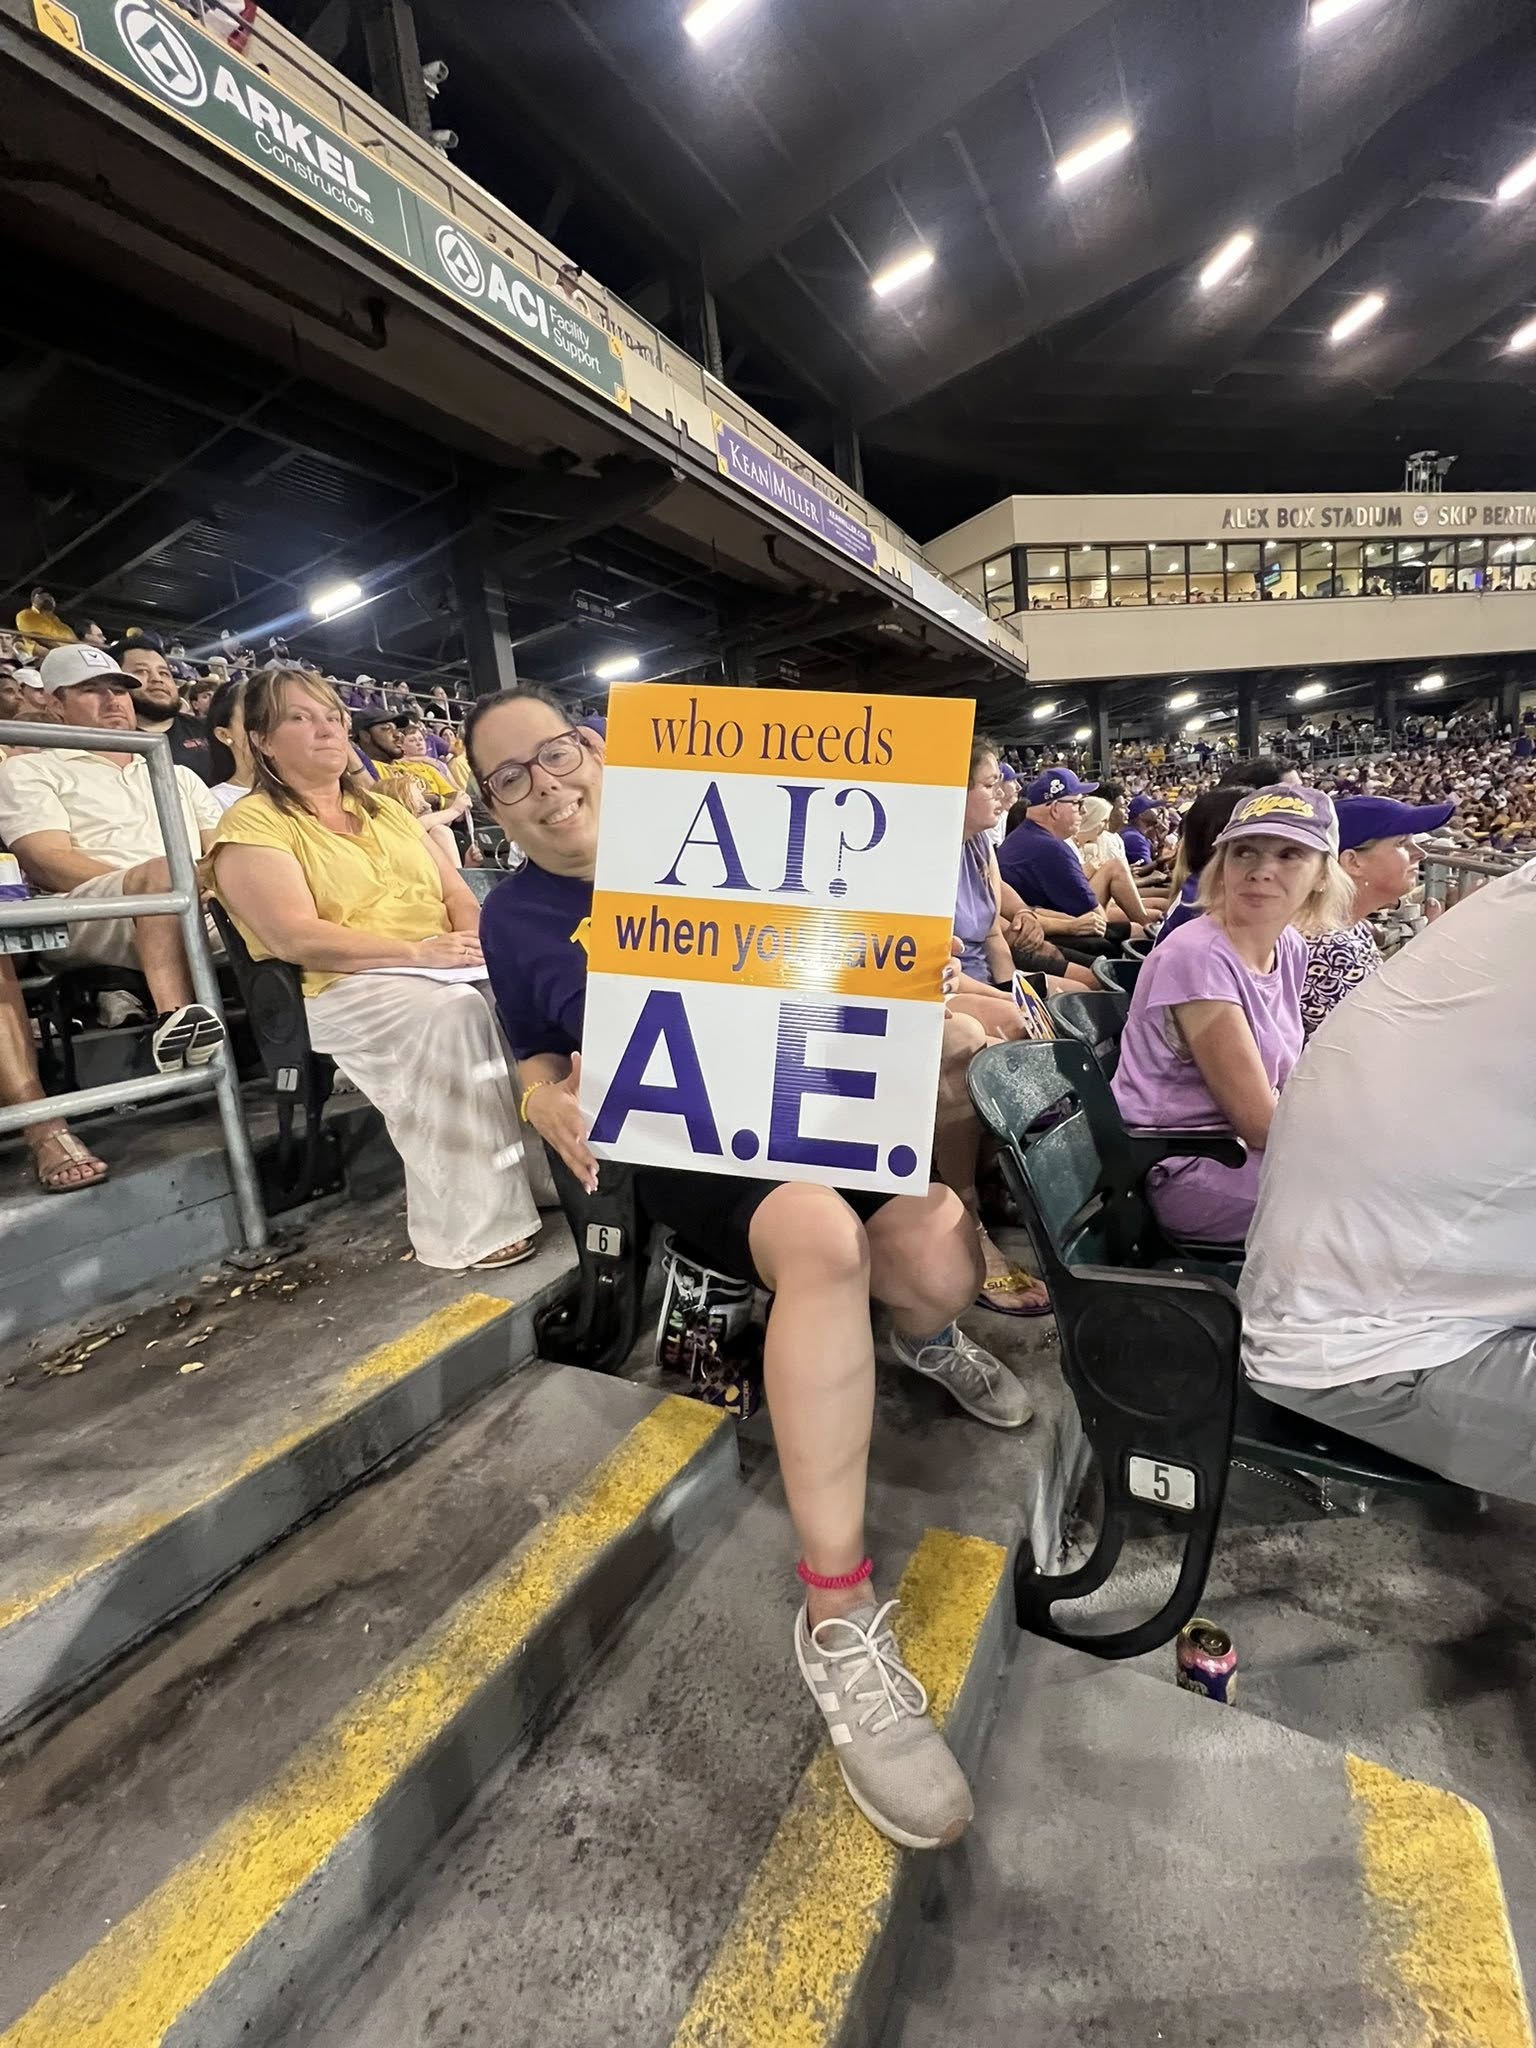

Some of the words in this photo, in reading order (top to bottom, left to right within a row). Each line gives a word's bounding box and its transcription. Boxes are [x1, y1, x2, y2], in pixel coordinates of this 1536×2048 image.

[213, 65, 371, 204] ARKEL
[255, 130, 375, 225] Constructors
[488, 262, 550, 339] ACI
[549, 305, 590, 350] Facility
[553, 327, 602, 374] Support
[1222, 508, 1270, 529] ALEX
[1277, 507, 1316, 528] BOX
[1320, 506, 1403, 528] STADIUM
[1437, 505, 1478, 526] SKIP
[651, 697, 744, 758] who
[760, 706, 894, 766] needs
[654, 780, 888, 898] AI?
[616, 905, 719, 957] when
[587, 989, 918, 1179] A.E.
[599, 1227, 608, 1253] 6
[1153, 1464, 1170, 1501] 5
